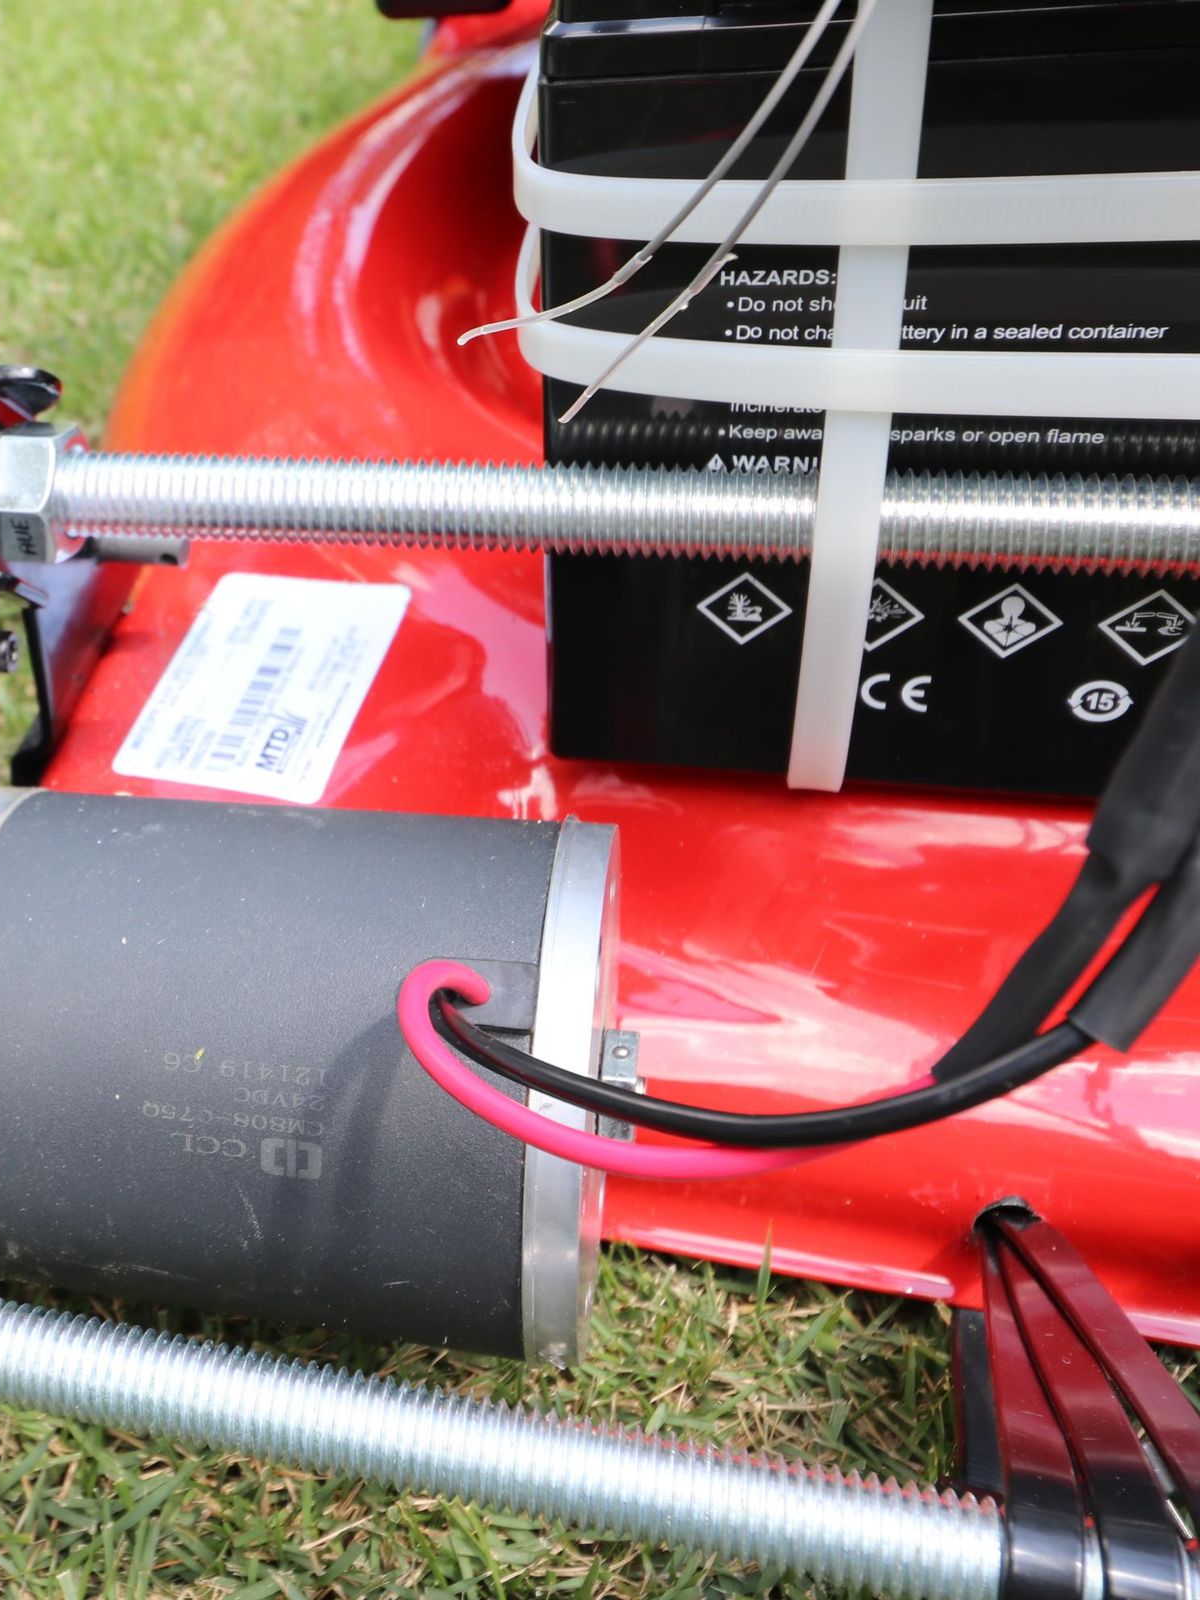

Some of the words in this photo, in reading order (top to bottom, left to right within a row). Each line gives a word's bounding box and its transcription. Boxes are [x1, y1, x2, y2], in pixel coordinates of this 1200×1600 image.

[720, 269, 837, 286] HAZARDS:
[738, 296, 766, 312] Do
[772, 297, 804, 312] not
[809, 296, 836, 312] sh
[903, 295, 928, 311] uit
[735, 324, 763, 341] Do
[768, 326, 800, 341] not
[804, 325, 834, 341] cha
[901, 324, 946, 343] ttery
[950, 323, 968, 340] in
[974, 327, 987, 340] a
[993, 323, 1064, 340] sealed
[1068, 323, 1170, 340] container
[728, 424, 778, 443] Keep
[783, 427, 823, 441] awa
[890, 427, 956, 445] sparks
[962, 430, 984, 442] or
[988, 429, 1040, 446] open
[1047, 428, 1105, 445] flame
[732, 455, 819, 473] WARNI
[861, 672, 932, 713] CE
[1086, 692, 1115, 711] 15
[255, 728, 291, 772] MTD
[171, 1132, 248, 1158] CCL
